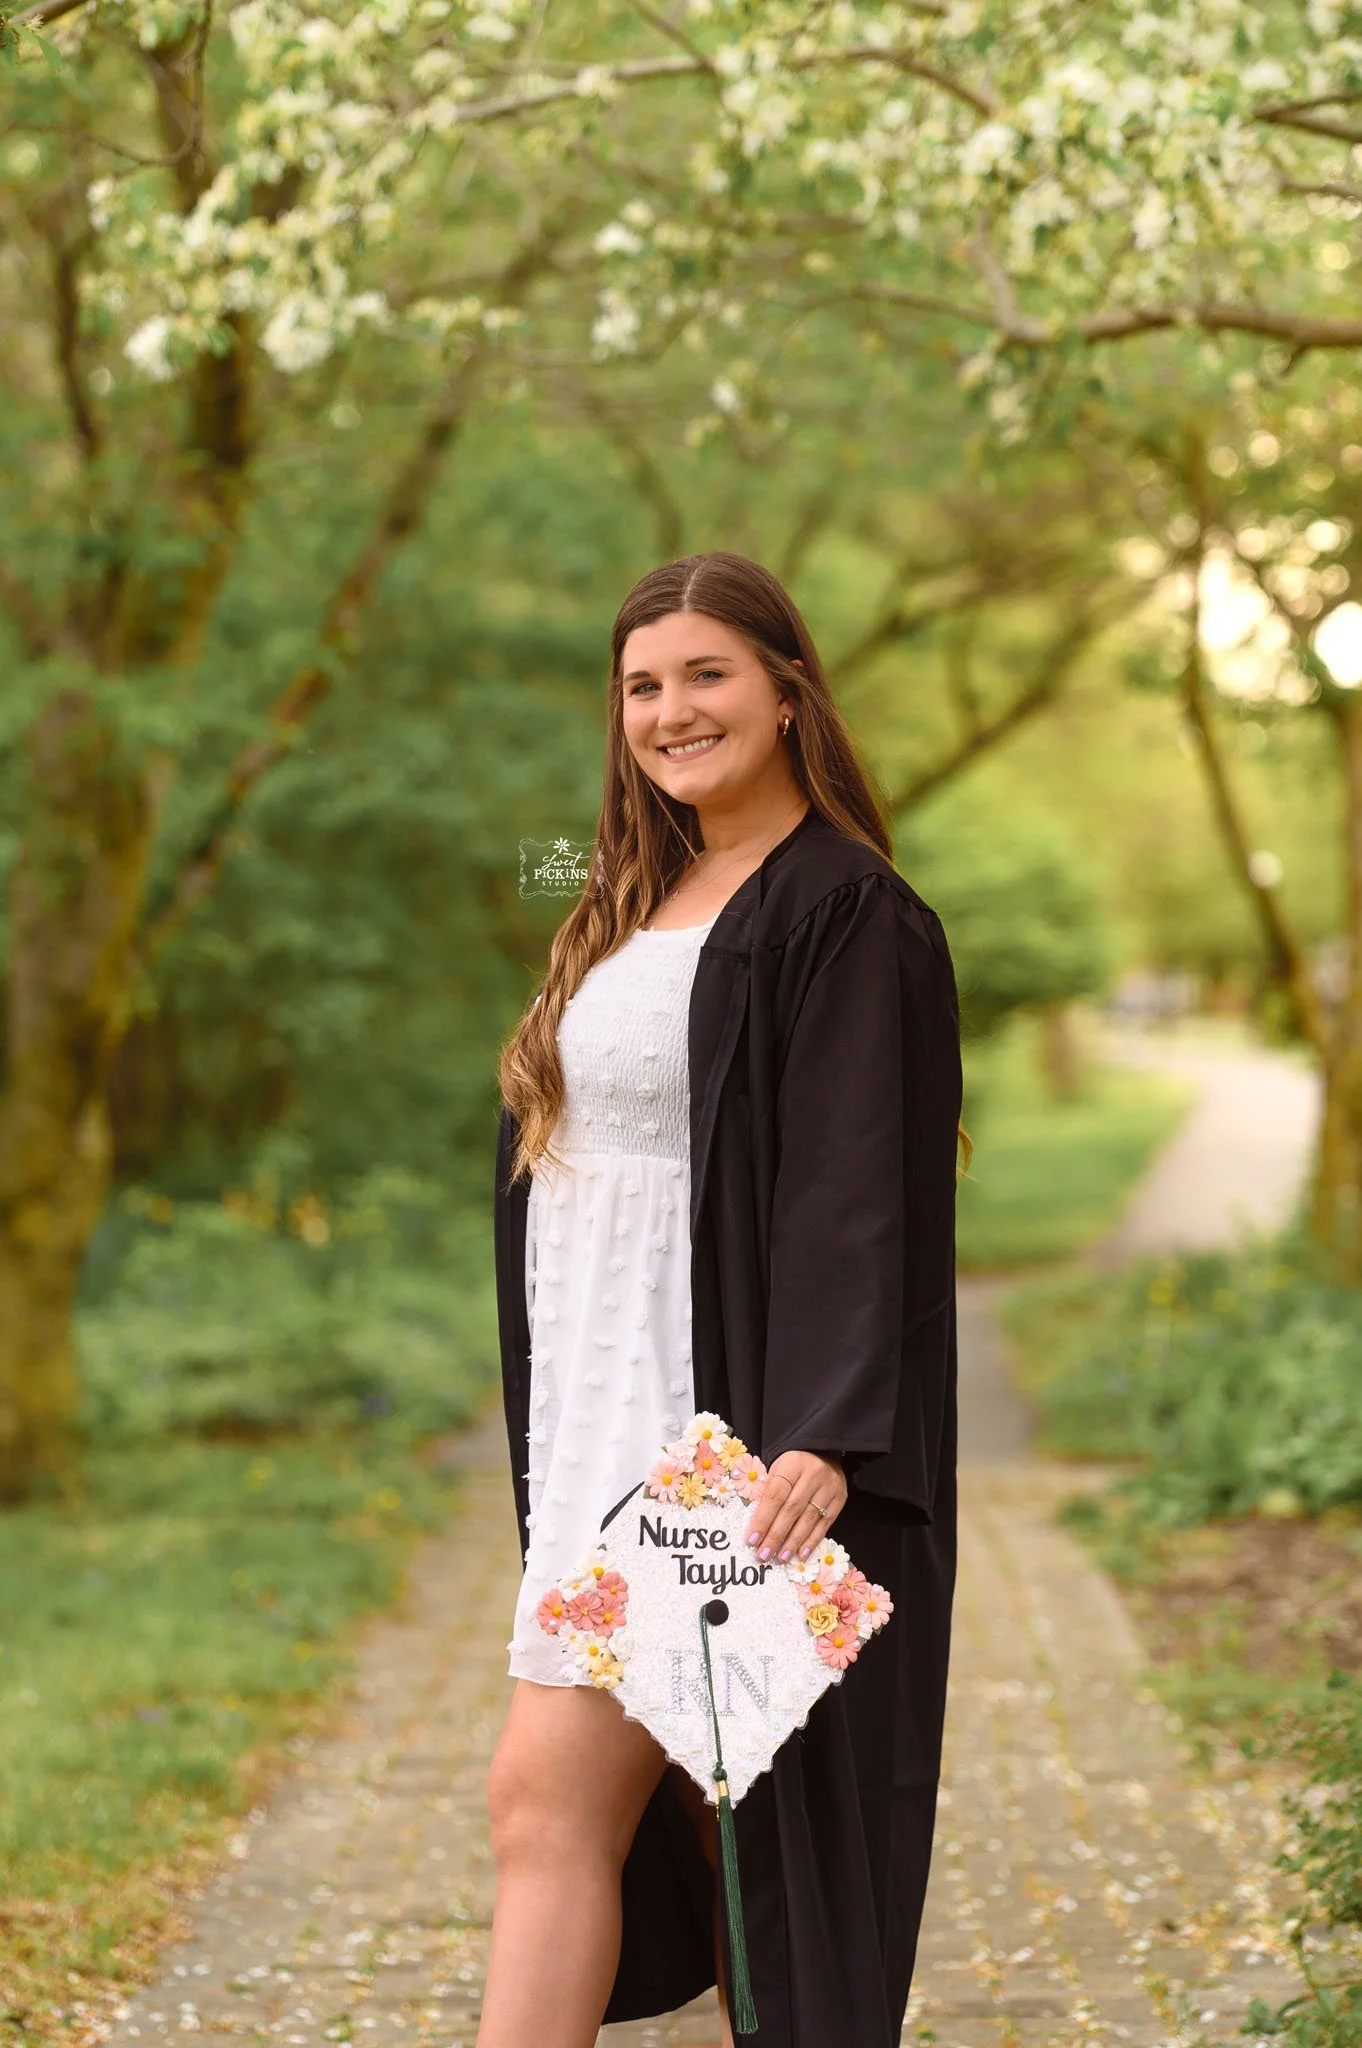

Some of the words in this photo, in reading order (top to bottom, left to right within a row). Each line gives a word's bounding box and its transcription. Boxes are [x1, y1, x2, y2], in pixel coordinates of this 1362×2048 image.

[639, 1515, 730, 1551] Nurse
[671, 1554, 772, 1595] Taylor
[665, 1649, 776, 1717] RN
